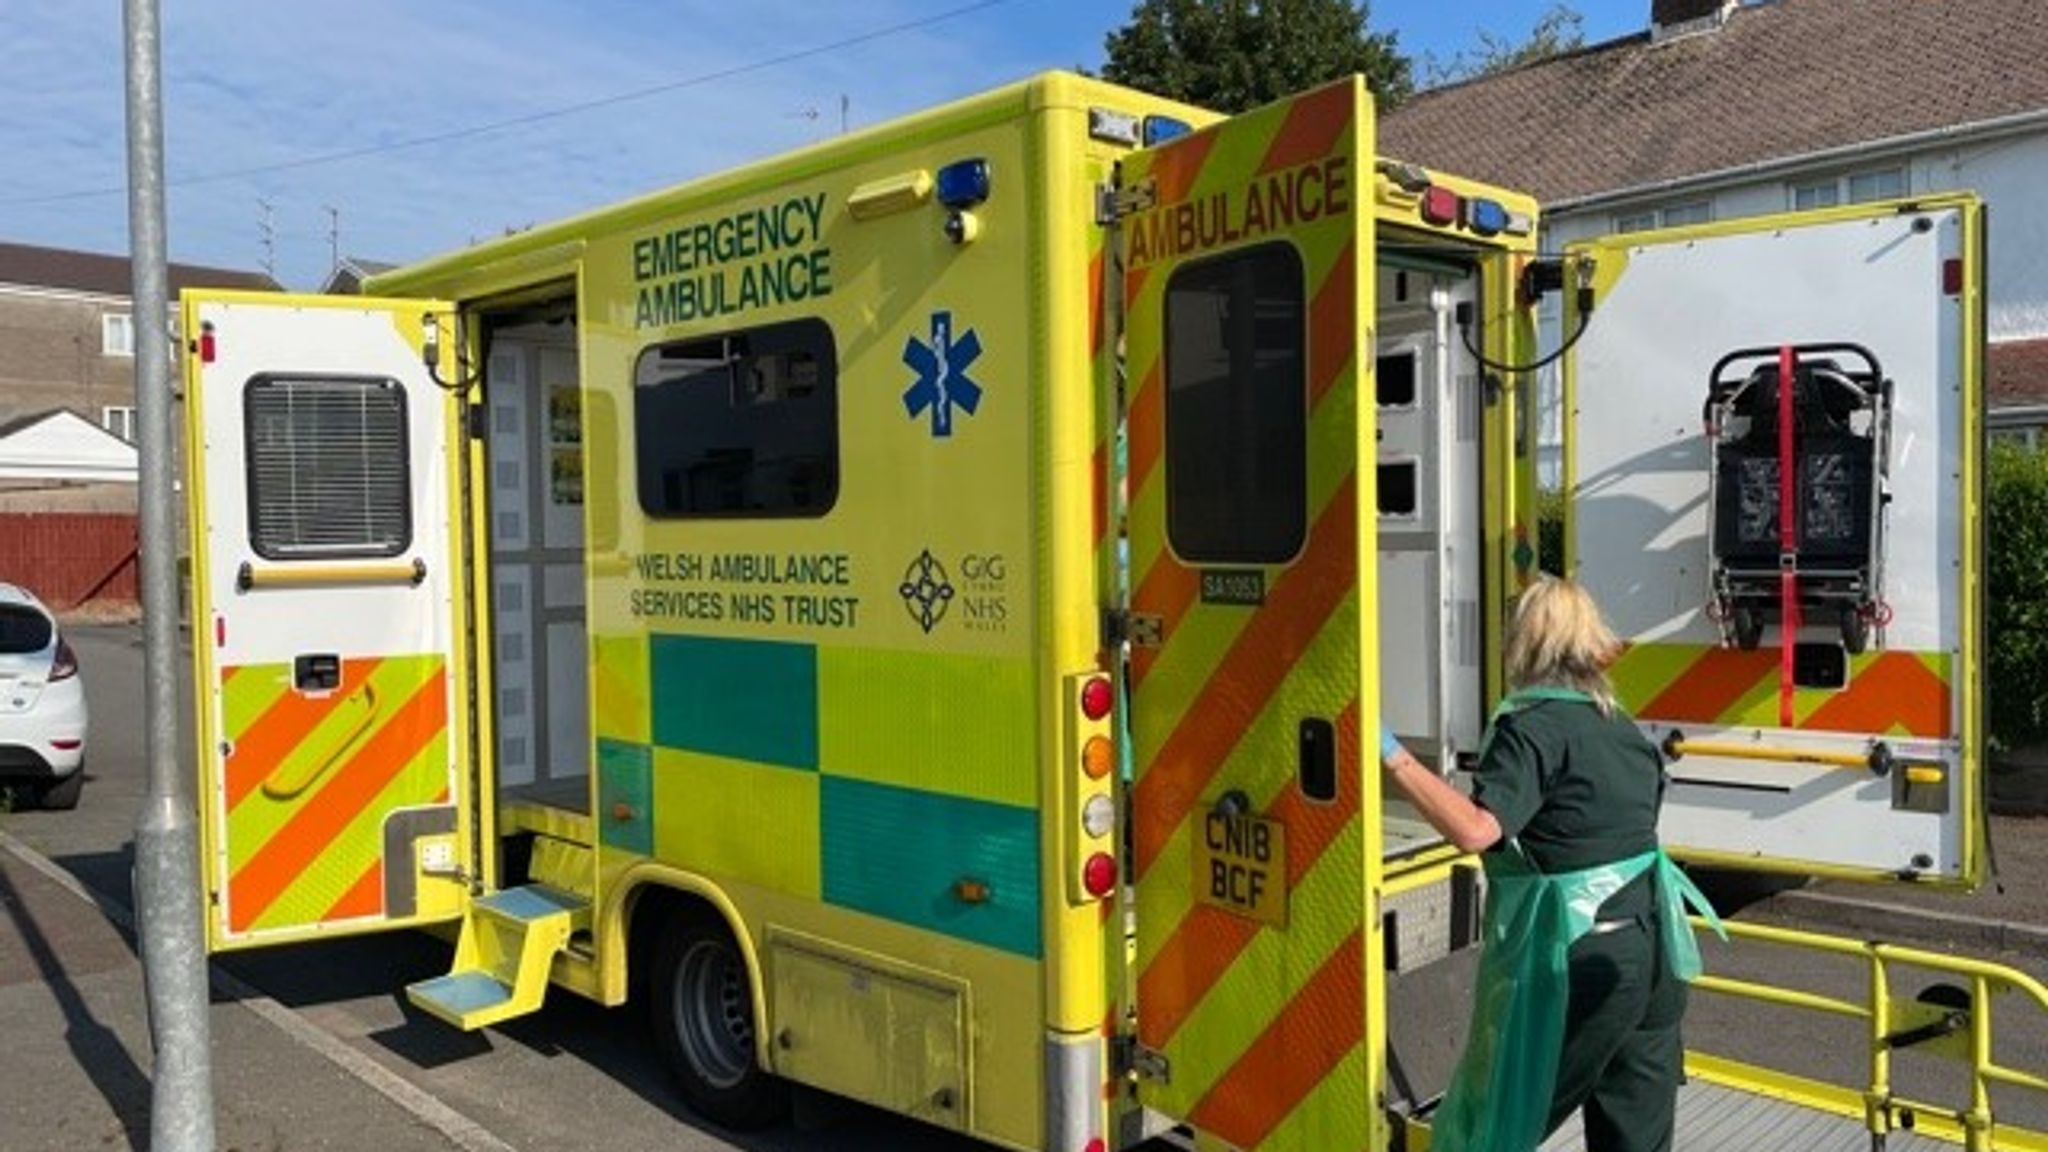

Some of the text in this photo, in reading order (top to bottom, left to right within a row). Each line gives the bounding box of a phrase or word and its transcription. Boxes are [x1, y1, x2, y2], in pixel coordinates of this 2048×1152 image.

[1128, 157, 1348, 265] AMBULANCE
[634, 193, 827, 281] EMERGENCY
[635, 249, 832, 329] AMBULANCE
[637, 553, 849, 584] WELSH AMBULANCE
[630, 589, 859, 627] SERVICES NHS TRUST
[962, 596, 1006, 621] NHS
[1206, 812, 1270, 862] CN18
[1210, 858, 1266, 909] BCF
